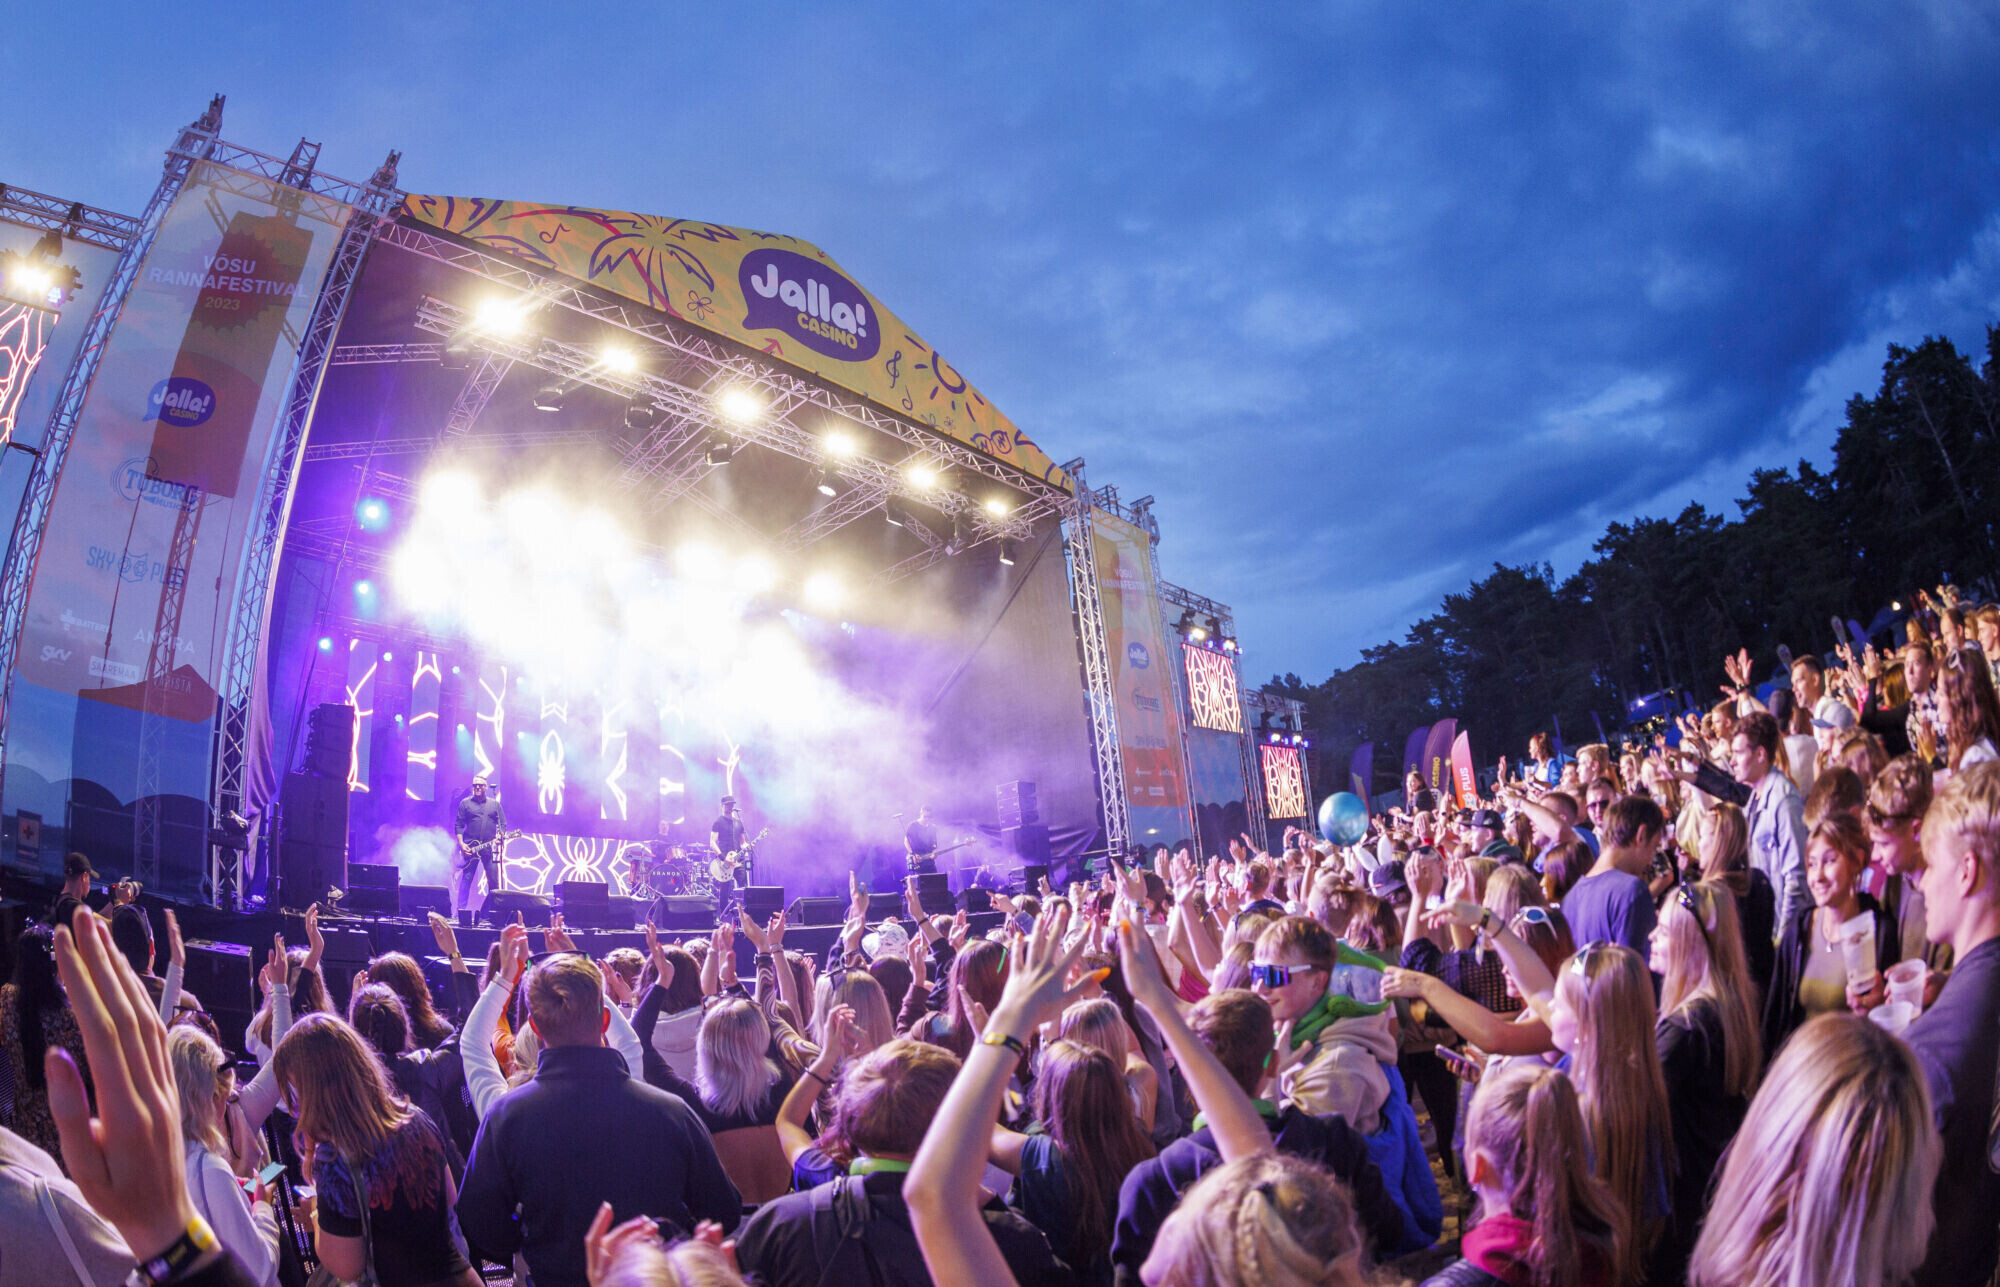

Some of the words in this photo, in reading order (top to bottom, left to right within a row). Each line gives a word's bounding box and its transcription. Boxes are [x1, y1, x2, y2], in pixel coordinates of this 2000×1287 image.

[203, 253, 256, 275] VÕSU
[150, 267, 310, 299] RANNAFESTIVAL
[204, 297, 241, 312] 2023
[751, 263, 867, 338] Jalla!
[797, 313, 858, 349] CASINO
[153, 386, 211, 414] Jalla!
[169, 406, 199, 421] CASINO
[125, 468, 199, 505] TUBORG
[86, 546, 116, 572] SKY
[1459, 767, 1472, 791] PLUS
